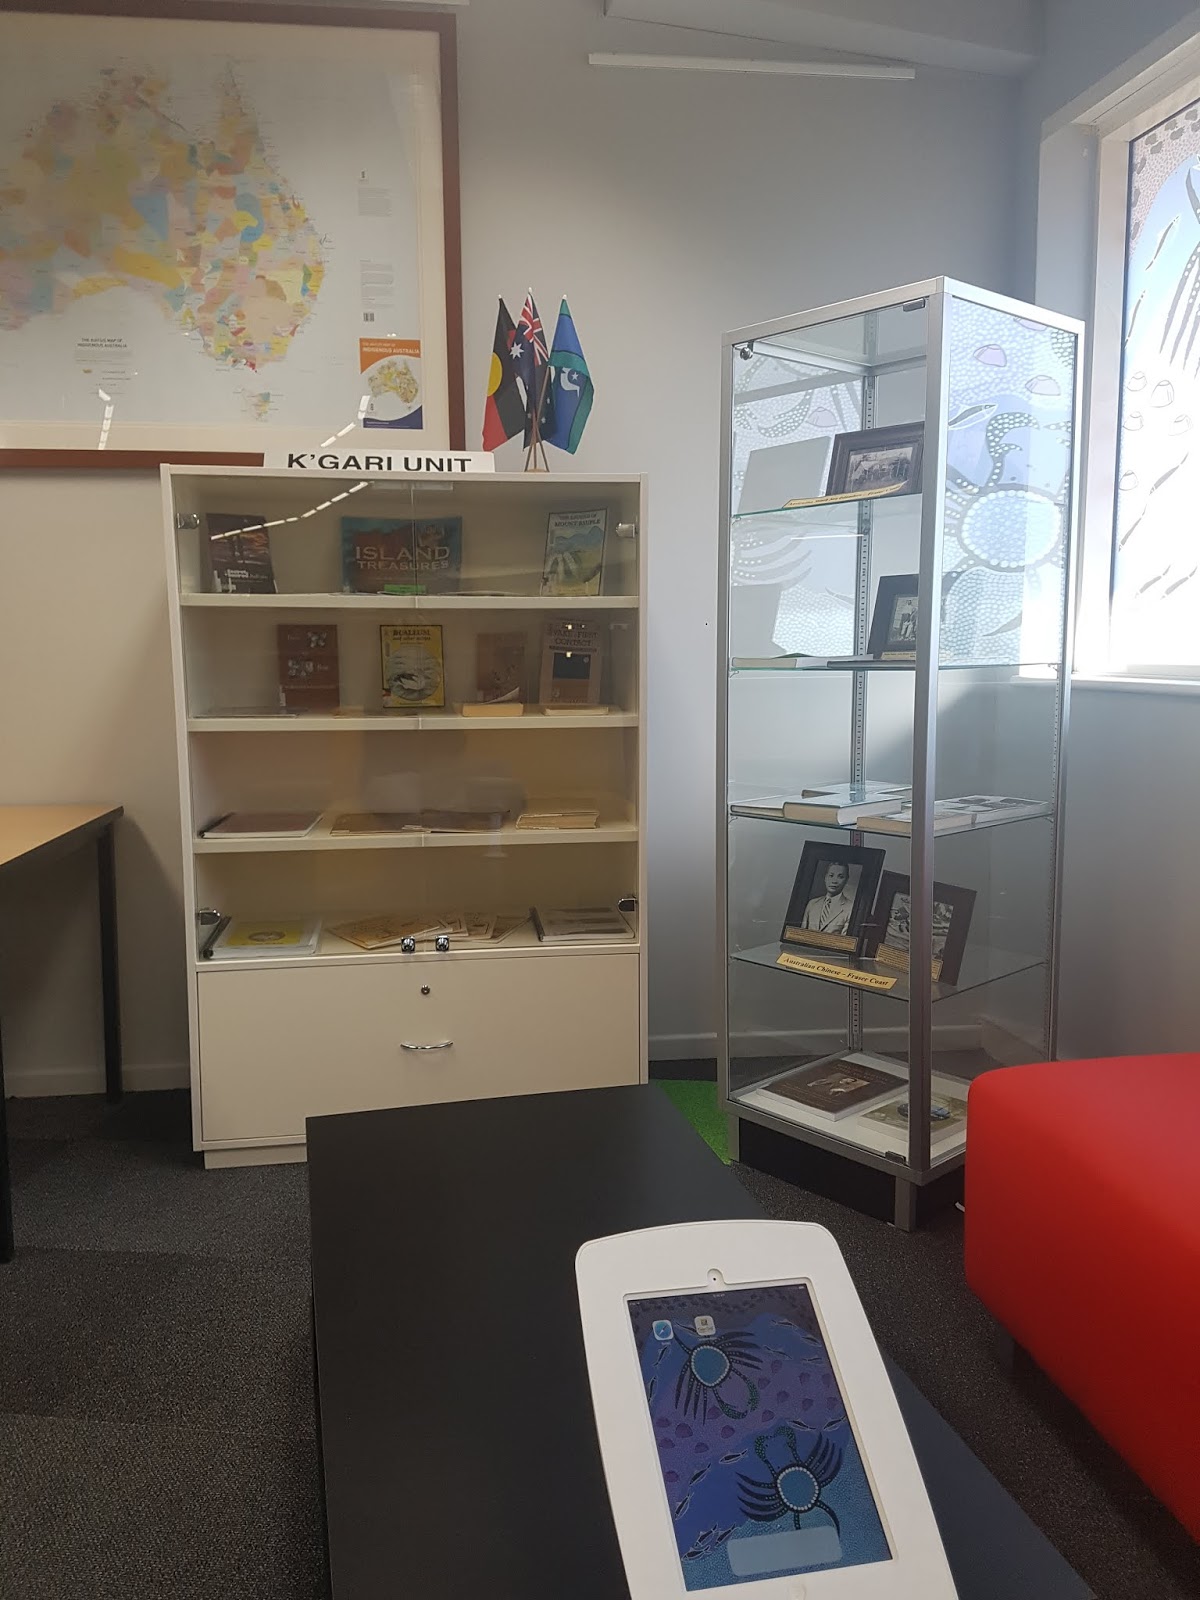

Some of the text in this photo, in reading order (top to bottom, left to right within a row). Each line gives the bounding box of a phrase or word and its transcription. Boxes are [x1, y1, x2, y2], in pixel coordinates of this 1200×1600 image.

[287, 453, 472, 472] K'GARI UNIT
[355, 546, 450, 560] ISLAND
[357, 560, 450, 570] TREASURES
[783, 957, 816, 970] Australian
[816, 965, 841, 976] Chinese
[847, 972, 869, 982] Fraser
[869, 977, 889, 986] Coast
